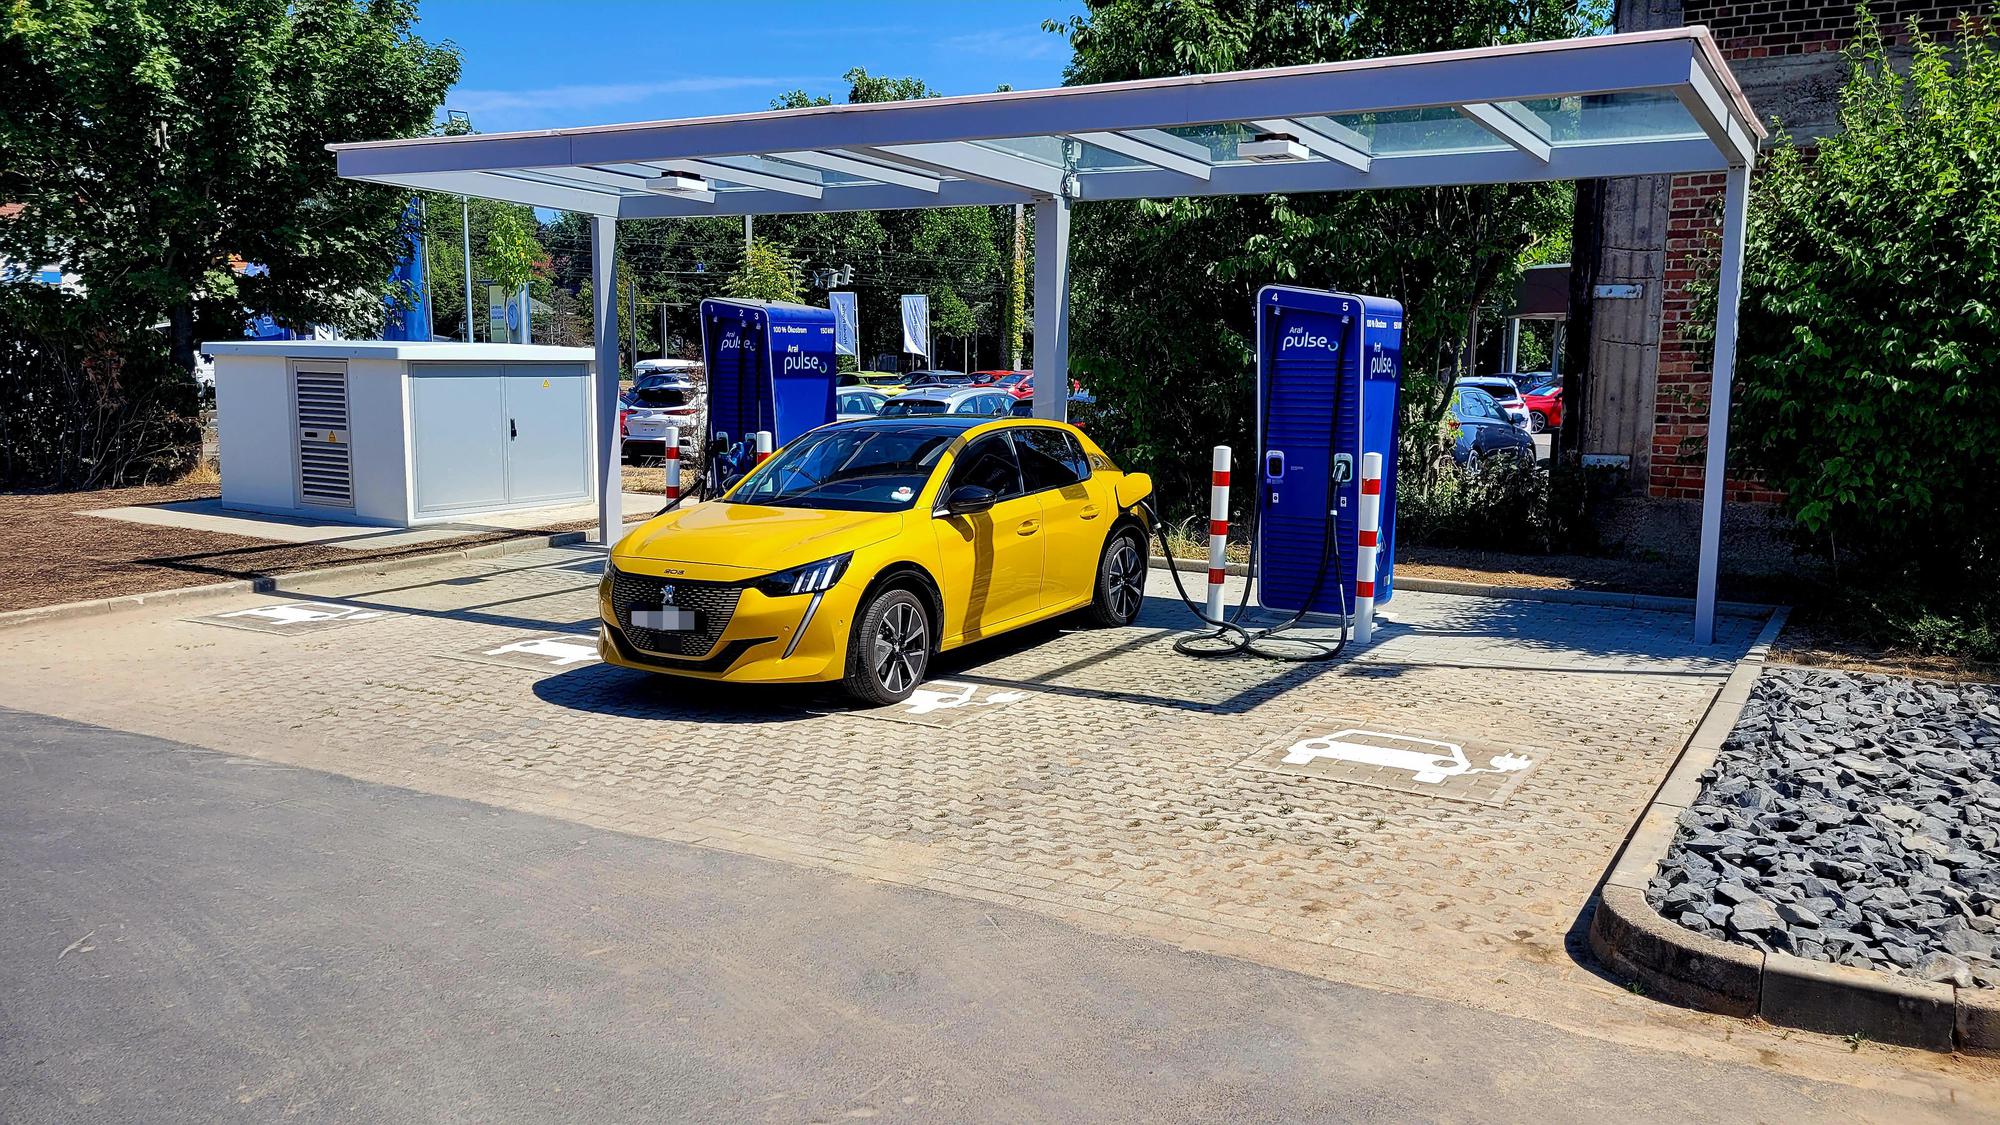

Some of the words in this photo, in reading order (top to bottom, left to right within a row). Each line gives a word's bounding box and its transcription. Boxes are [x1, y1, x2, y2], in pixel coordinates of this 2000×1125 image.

[1272, 293, 1278, 302] 4
[1342, 302, 1349, 311] 5
[739, 309, 744, 317] 2
[754, 312, 759, 320] 3
[1289, 326, 1304, 334] Aral
[1282, 331, 1328, 351] pulse
[787, 344, 799, 353] Aral
[784, 351, 819, 375] pulse
[1370, 350, 1392, 380] pulse
